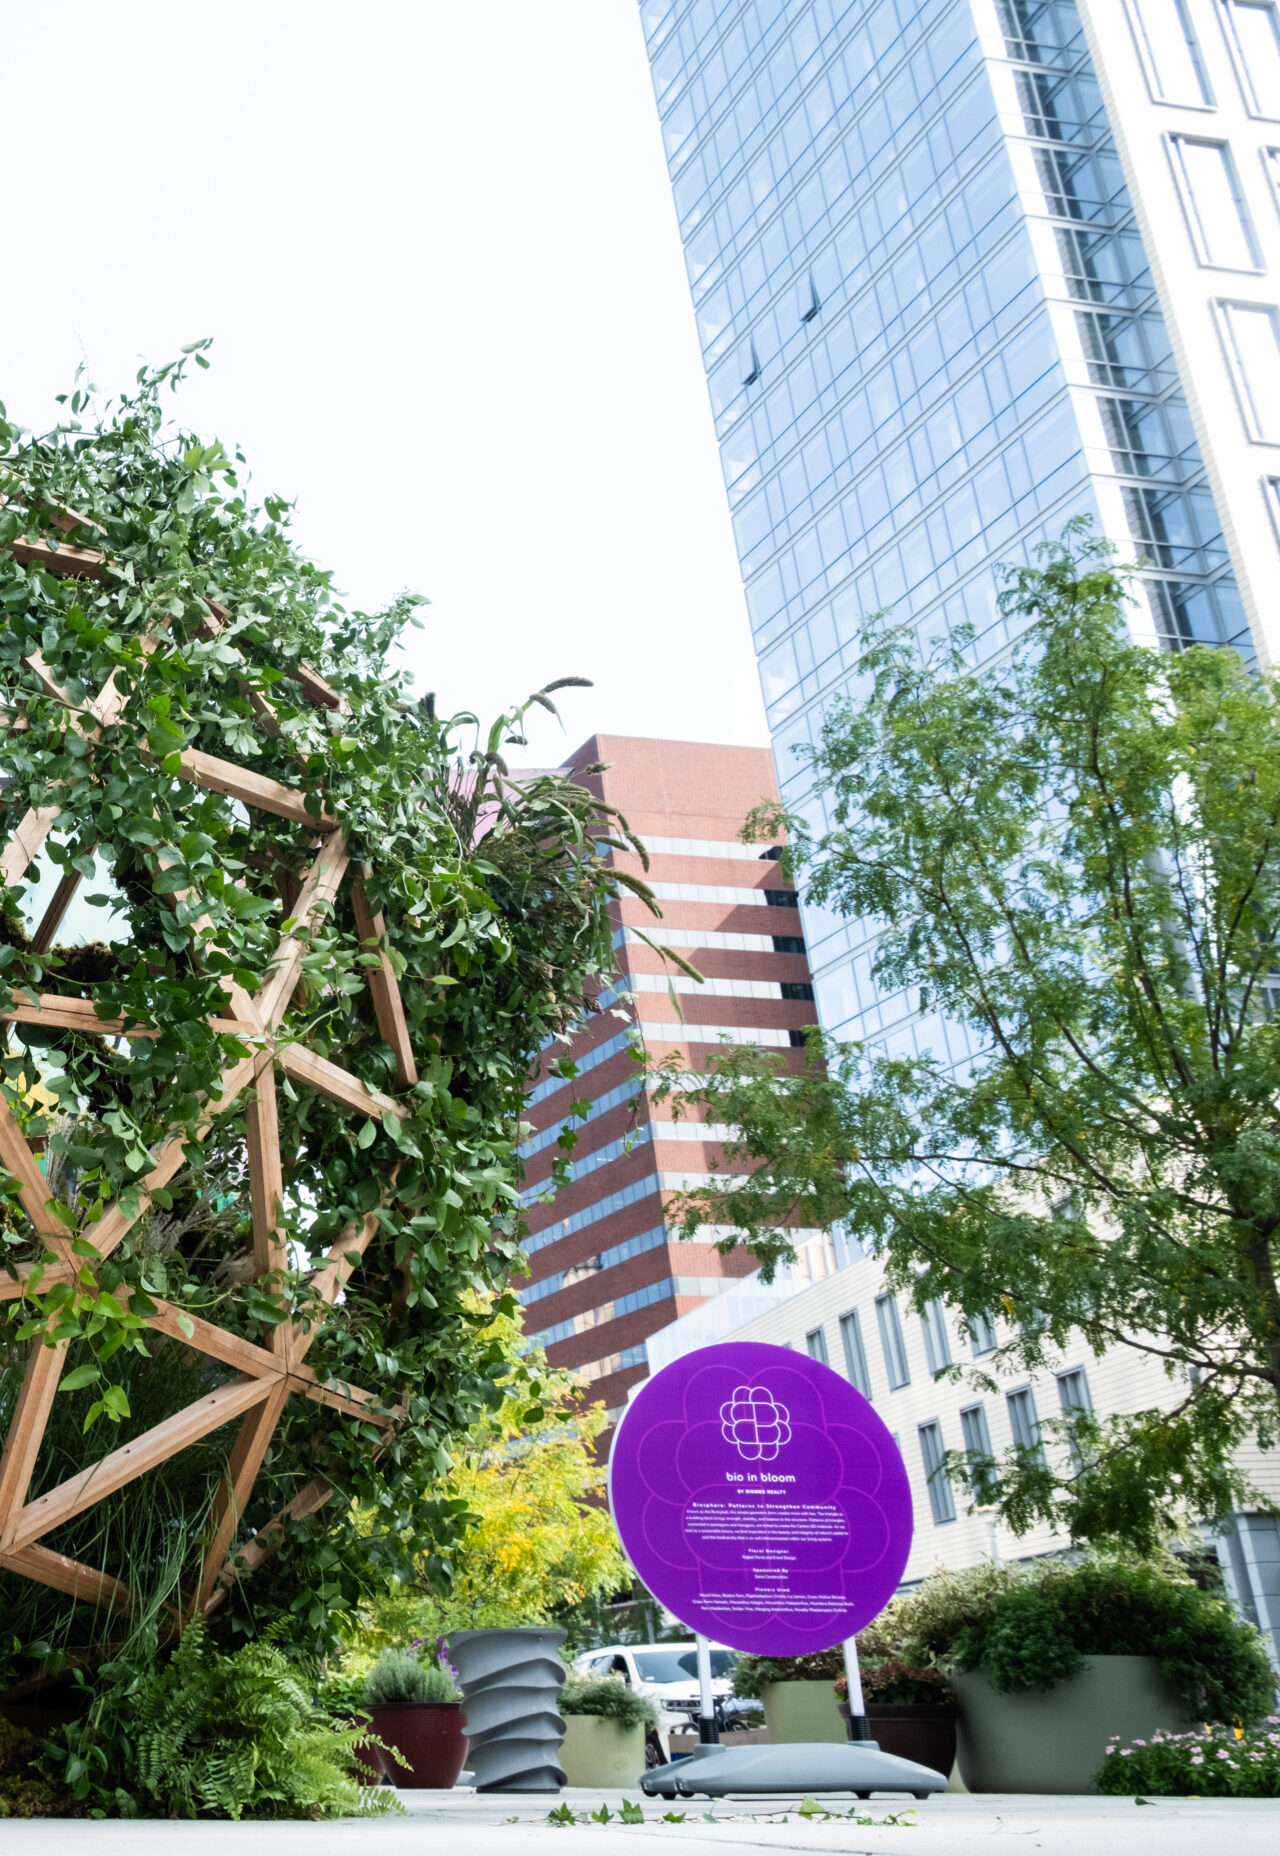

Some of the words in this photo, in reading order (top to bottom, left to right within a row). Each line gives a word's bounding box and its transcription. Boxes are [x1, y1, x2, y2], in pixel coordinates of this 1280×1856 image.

[726, 1472, 744, 1482] bio
[747, 1472, 758, 1482] in
[760, 1473, 796, 1483] bloom
